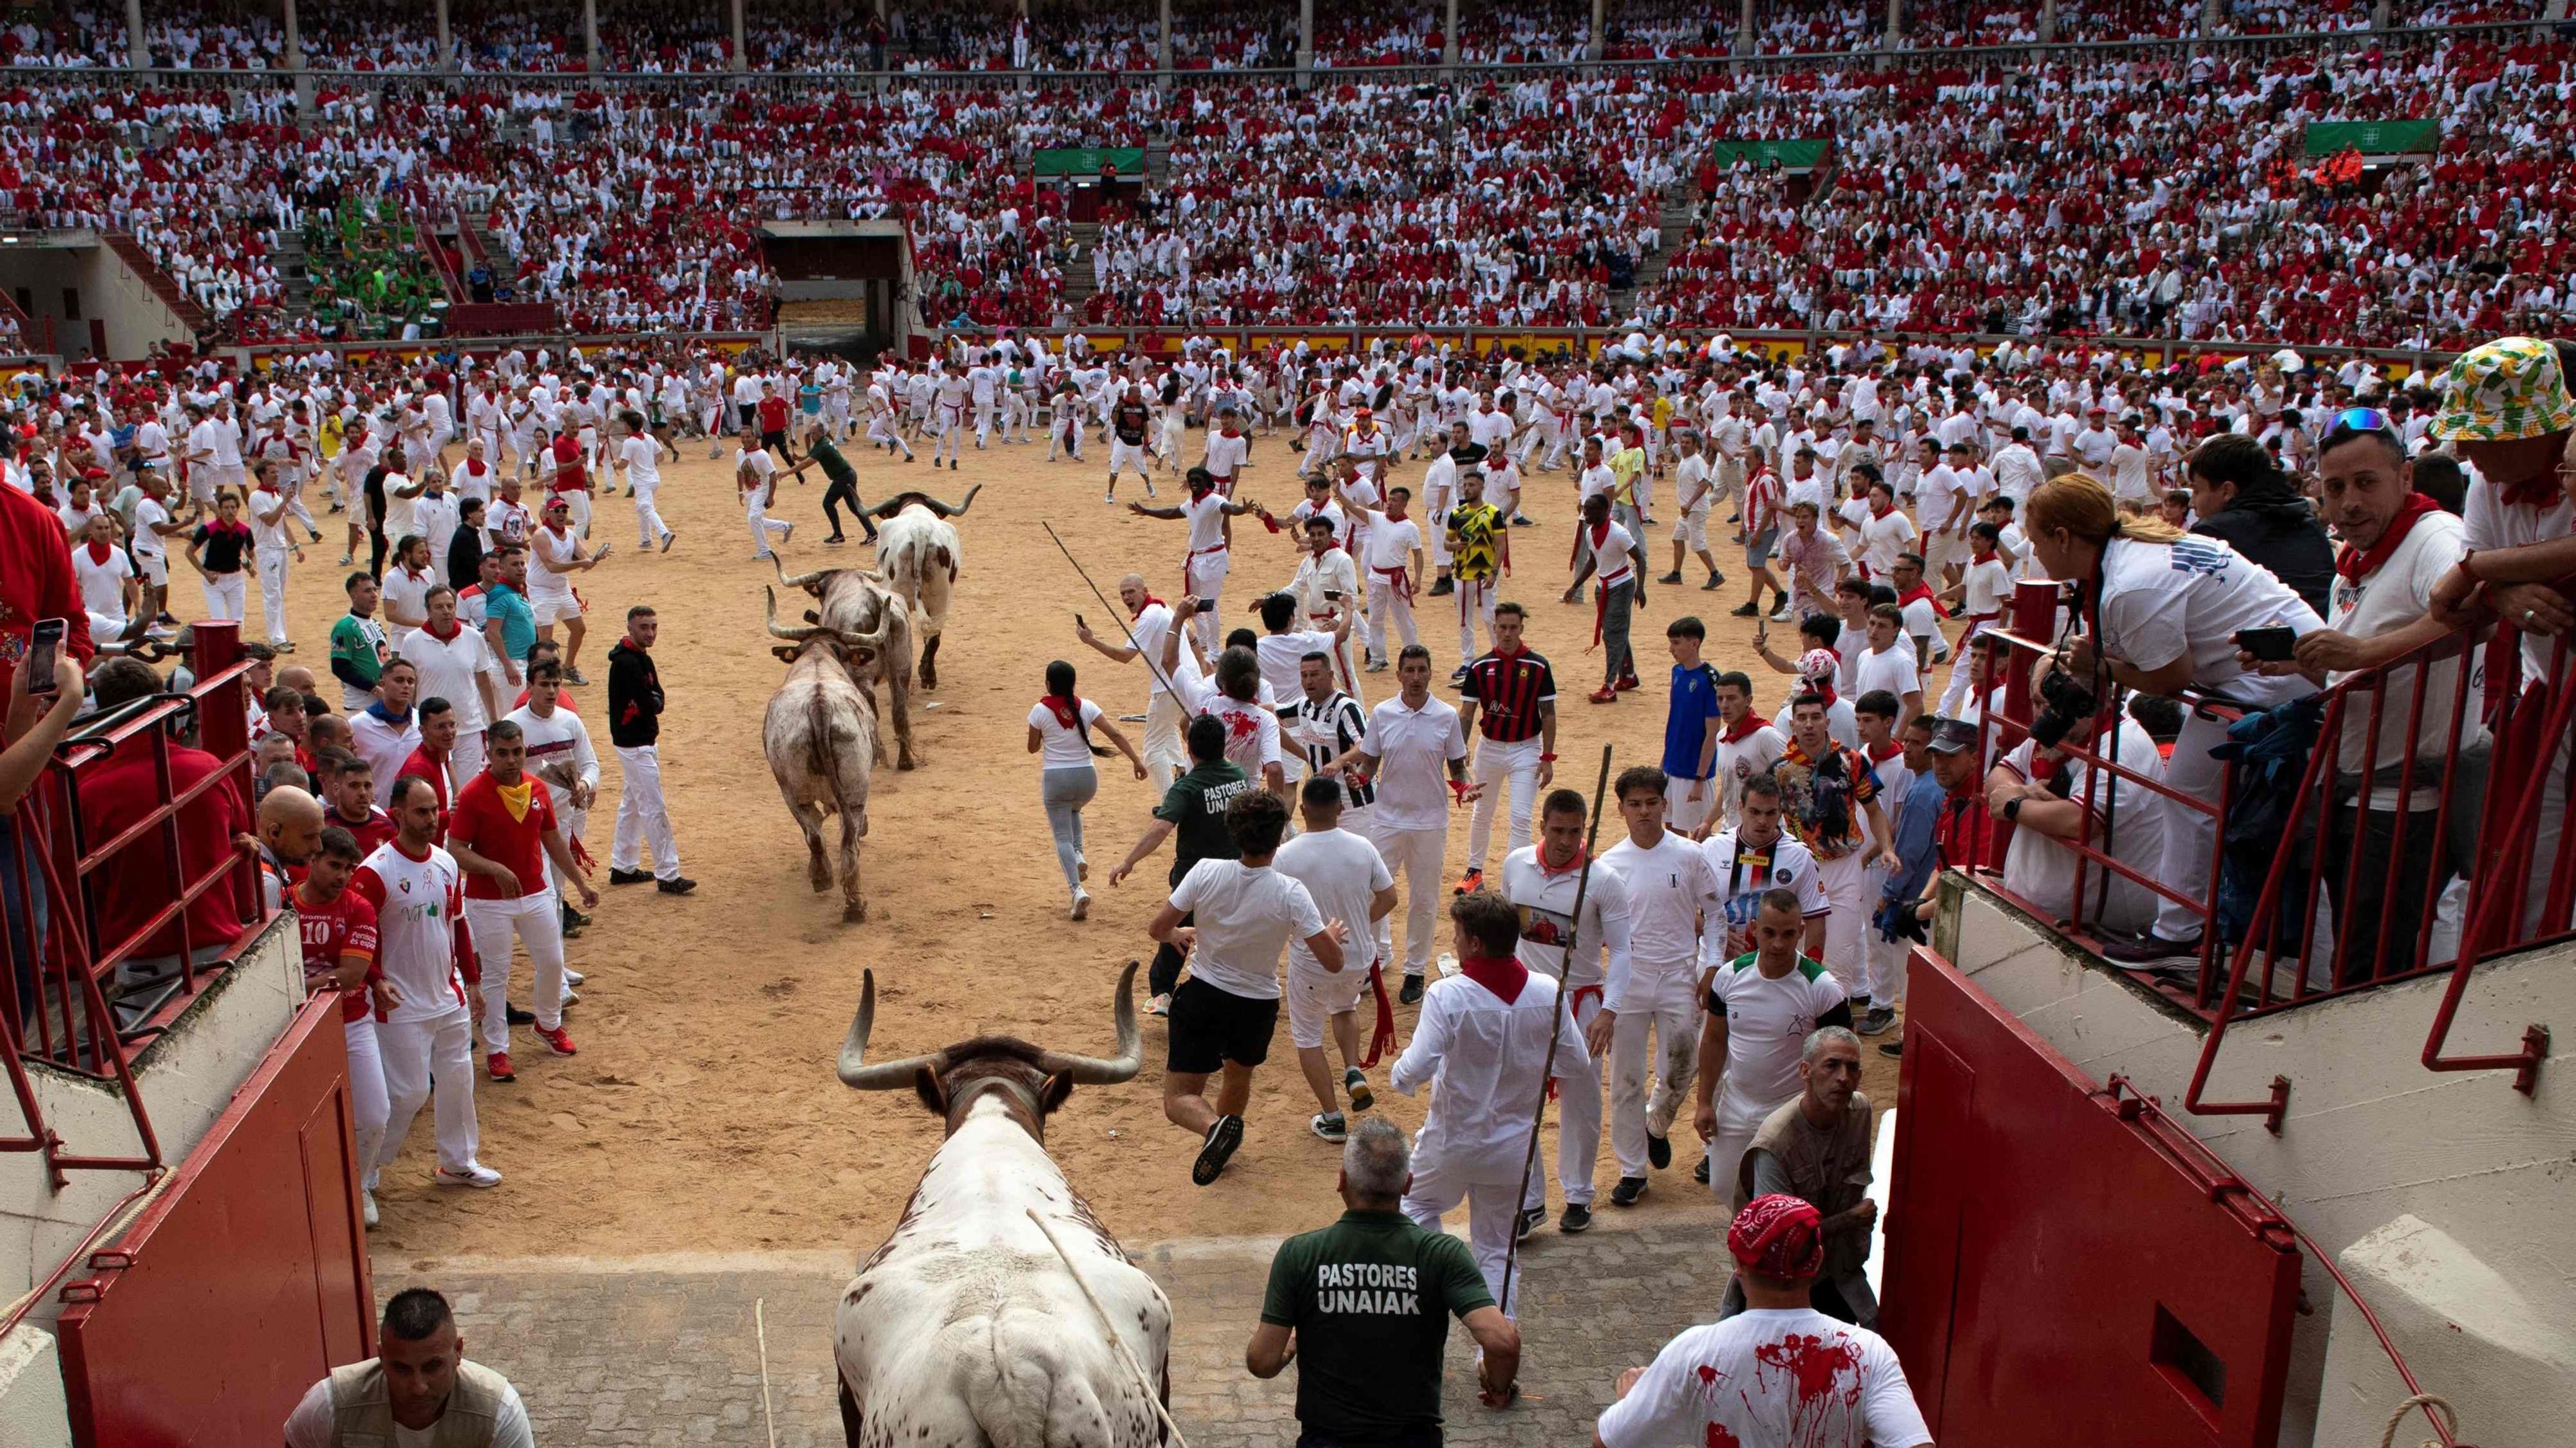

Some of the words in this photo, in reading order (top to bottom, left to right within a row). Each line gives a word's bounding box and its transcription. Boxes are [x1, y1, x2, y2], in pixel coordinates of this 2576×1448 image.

[1203, 779, 1247, 802] PASTORES
[302, 921, 330, 945] 10
[1318, 1263, 1417, 1290] PASTORES
[1318, 1290, 1421, 1315] UNAIAK
